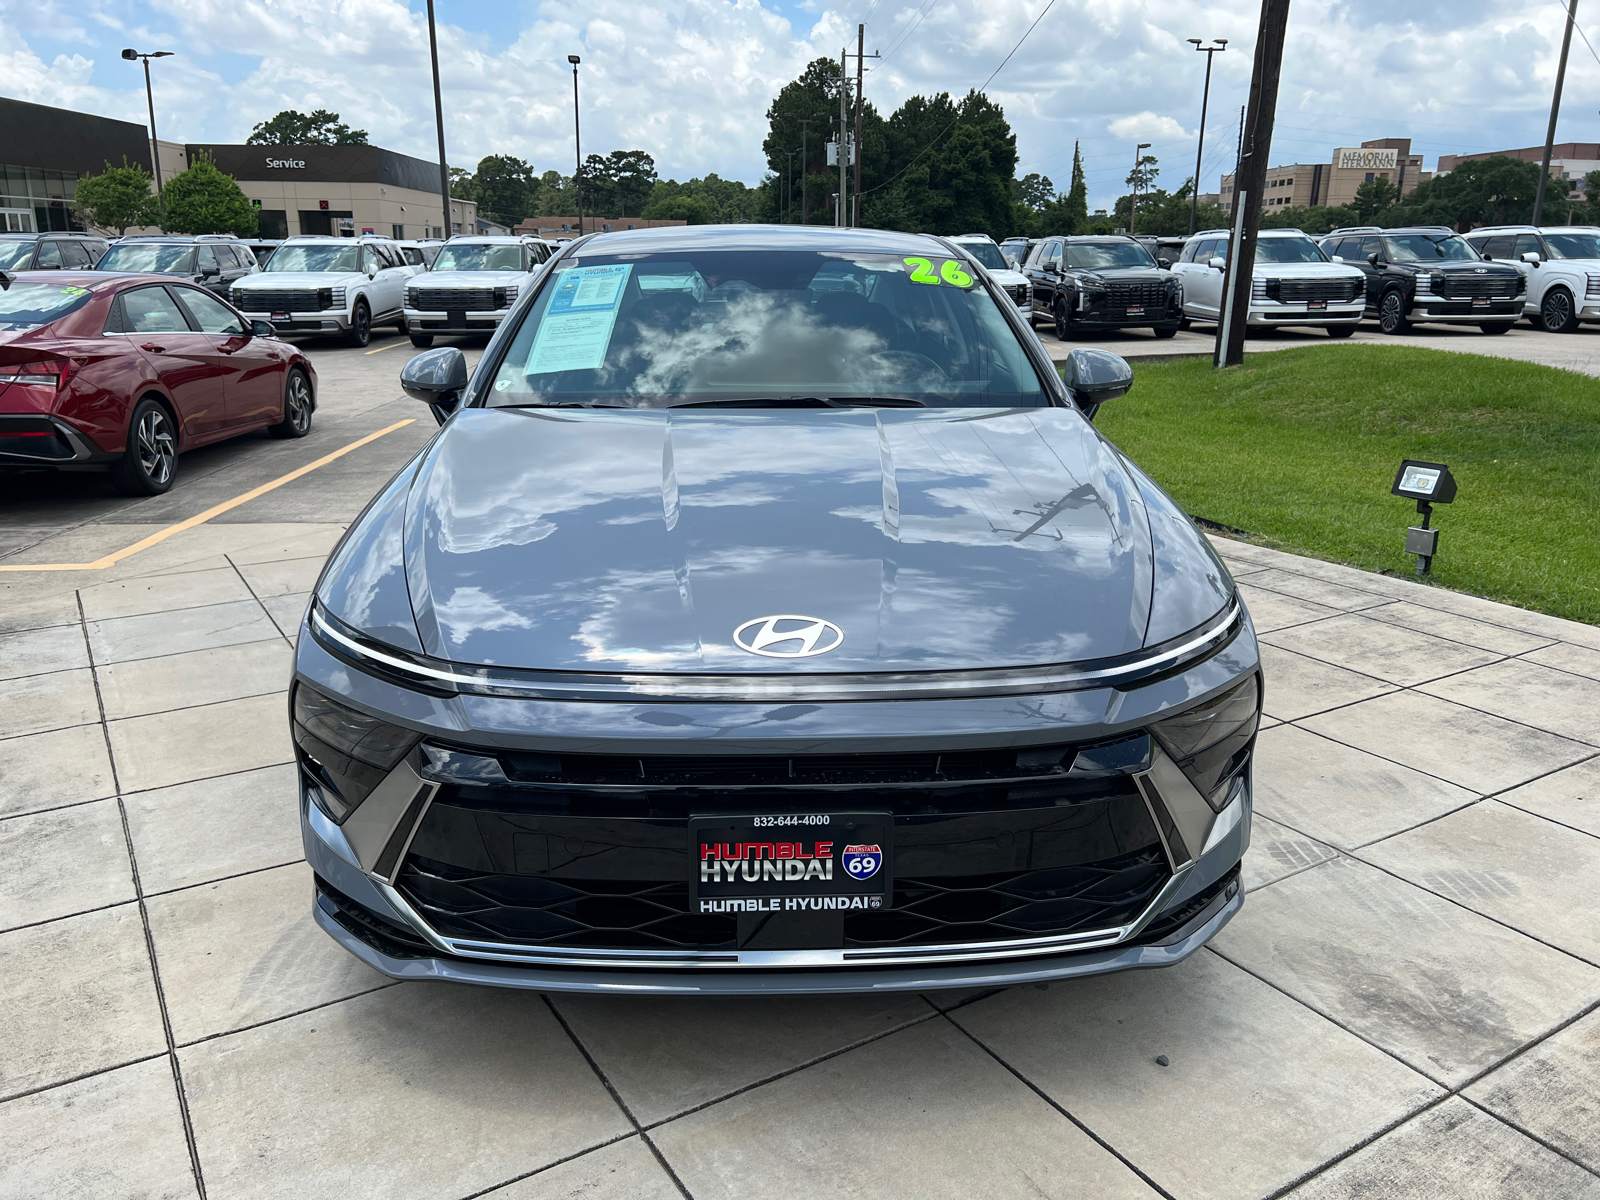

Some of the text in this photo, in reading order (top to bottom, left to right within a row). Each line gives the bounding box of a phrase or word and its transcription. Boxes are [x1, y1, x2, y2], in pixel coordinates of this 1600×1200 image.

[265, 157, 306, 169] Service
[1342, 151, 1395, 160] MEMORIAL
[1341, 160, 1395, 168] HERMANN
[903, 257, 974, 288] 26
[753, 815, 830, 827] 832-644-4000
[701, 841, 834, 860] HUMBLE
[701, 859, 833, 882] HYUNDAI
[849, 857, 876, 873] 69
[700, 898, 781, 913] HUMBLE
[785, 896, 869, 910] HYUNDAI
